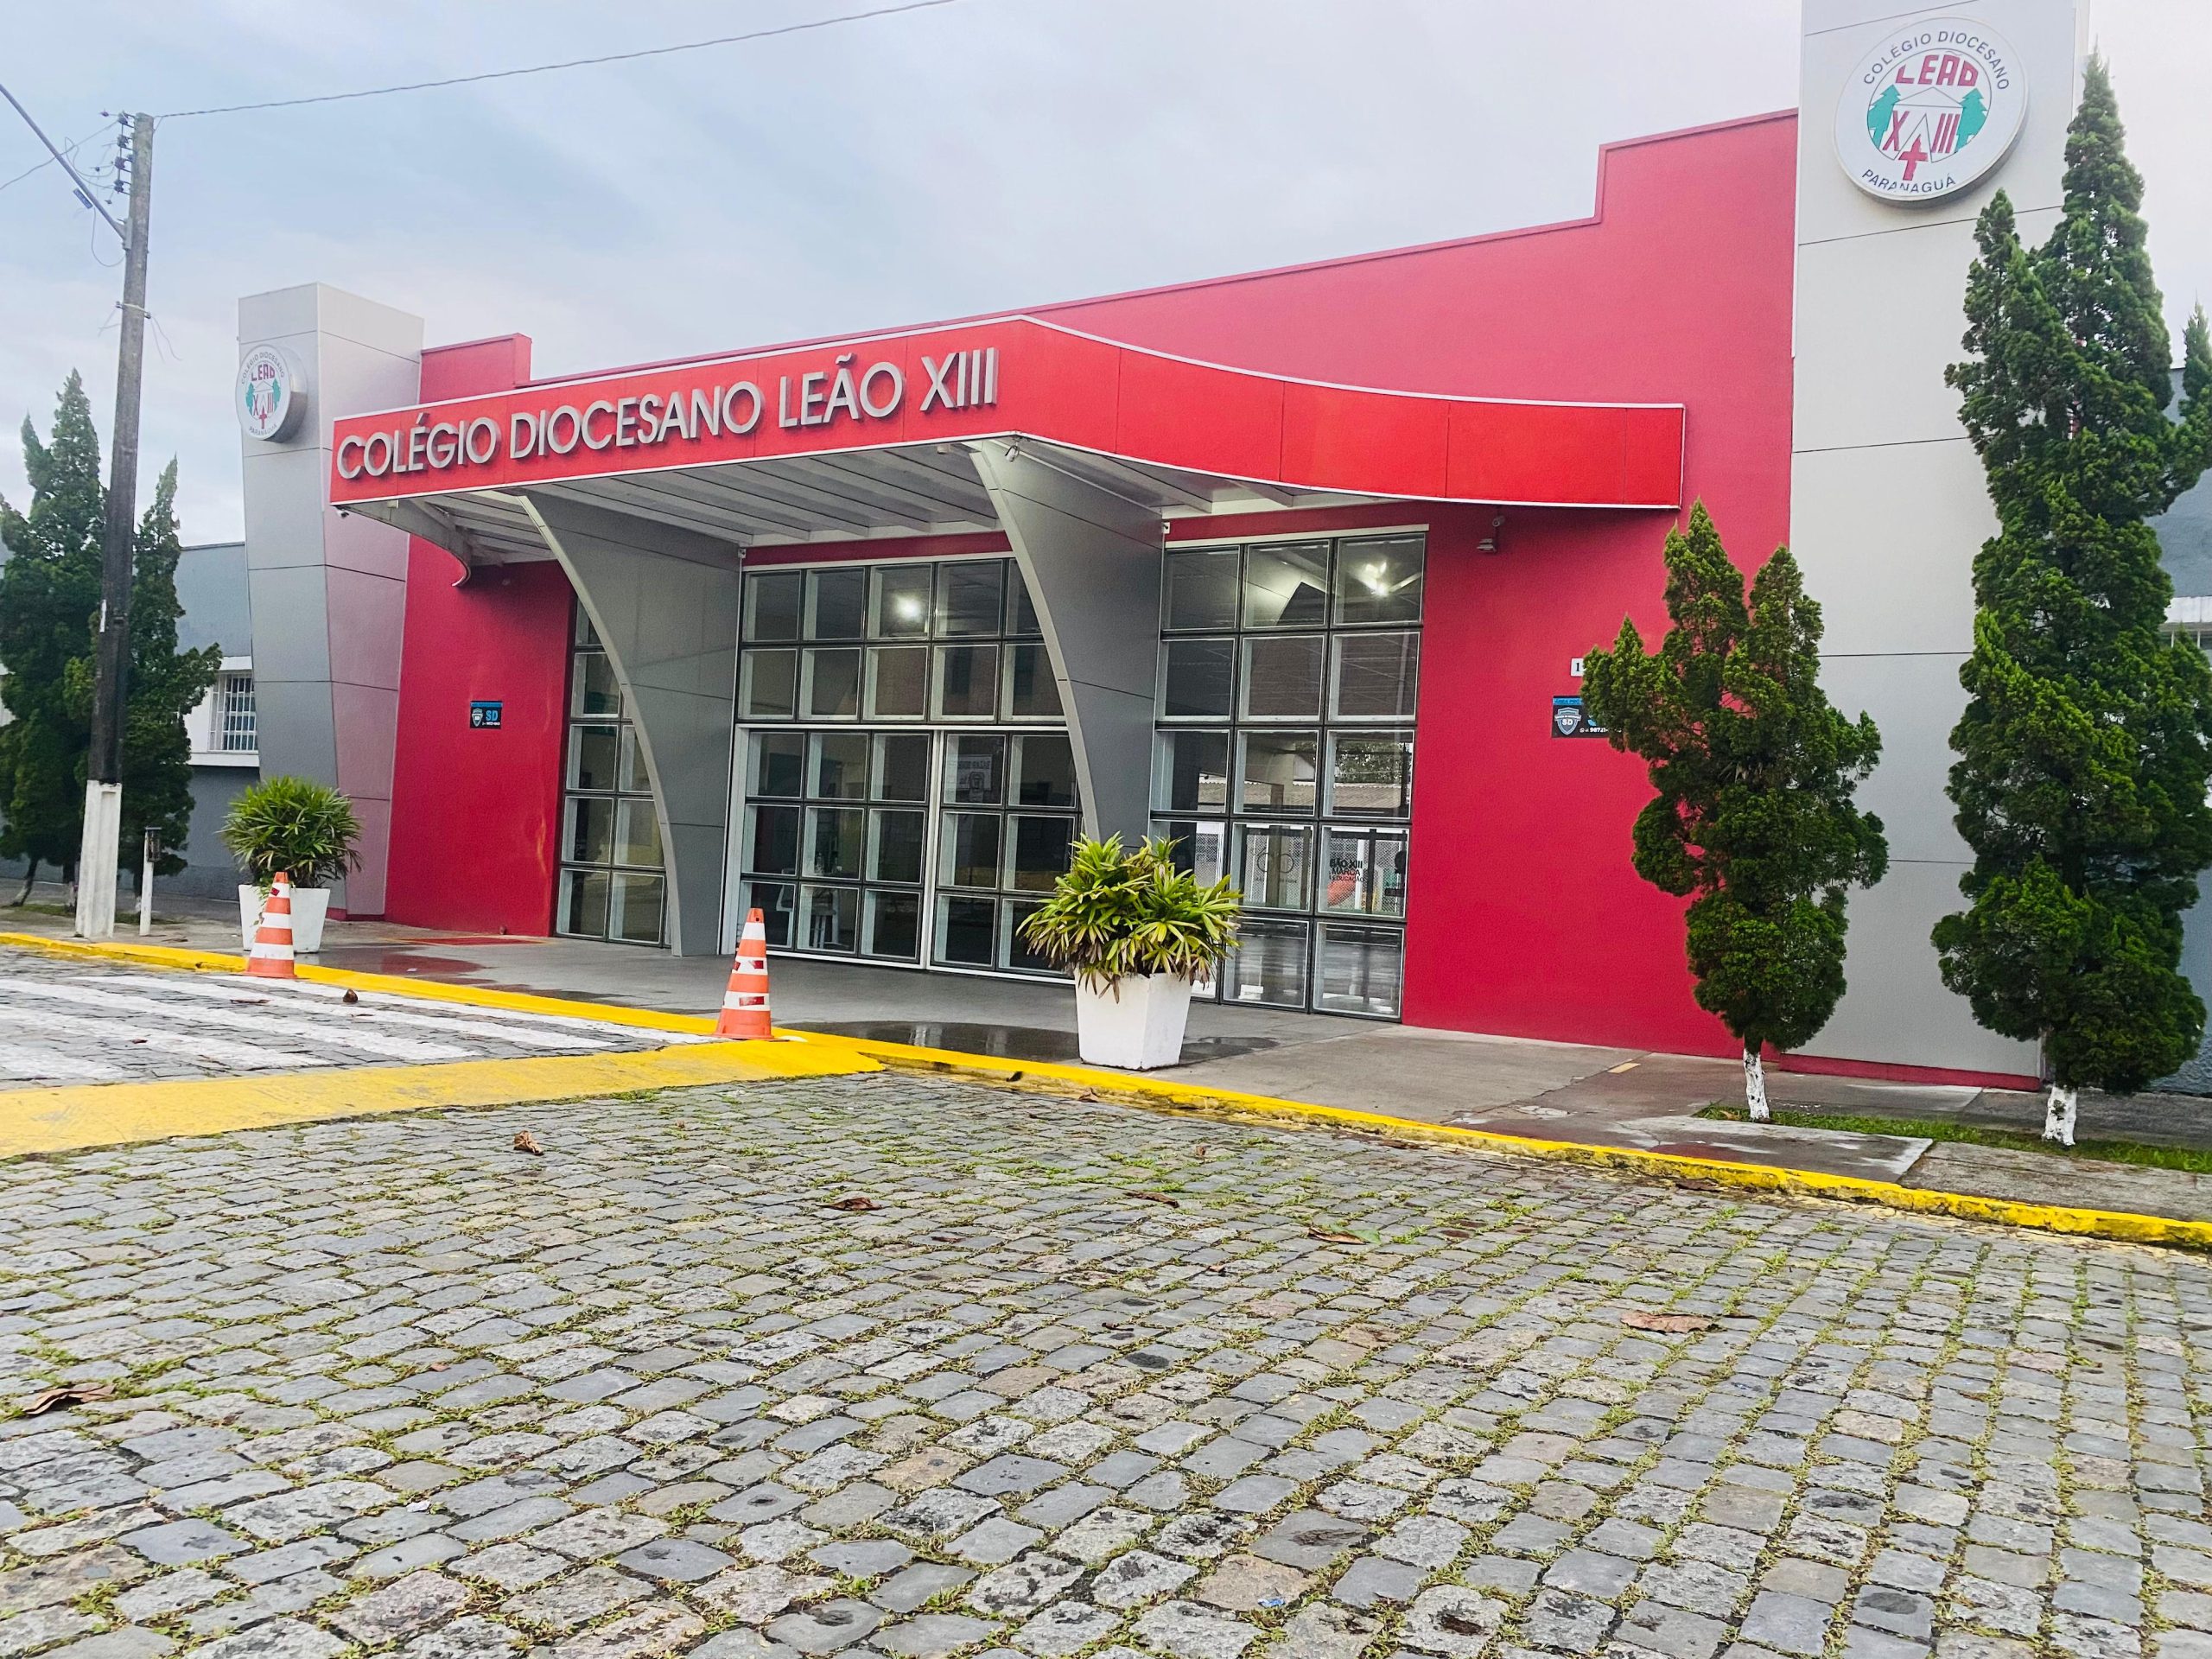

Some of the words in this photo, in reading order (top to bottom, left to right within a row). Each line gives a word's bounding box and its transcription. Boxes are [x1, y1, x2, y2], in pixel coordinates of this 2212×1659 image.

[1863, 33, 1932, 85] COLÉGIO
[1938, 30, 2010, 90] DIOCESANO
[1862, 168, 1956, 194] PARANAGUÁ
[336, 412, 501, 480] COLÉGIO
[510, 381, 765, 460] DIOCESANO
[779, 353, 905, 429] LEÃO
[919, 346, 998, 411] XIII
[486, 709, 499, 721] SD
